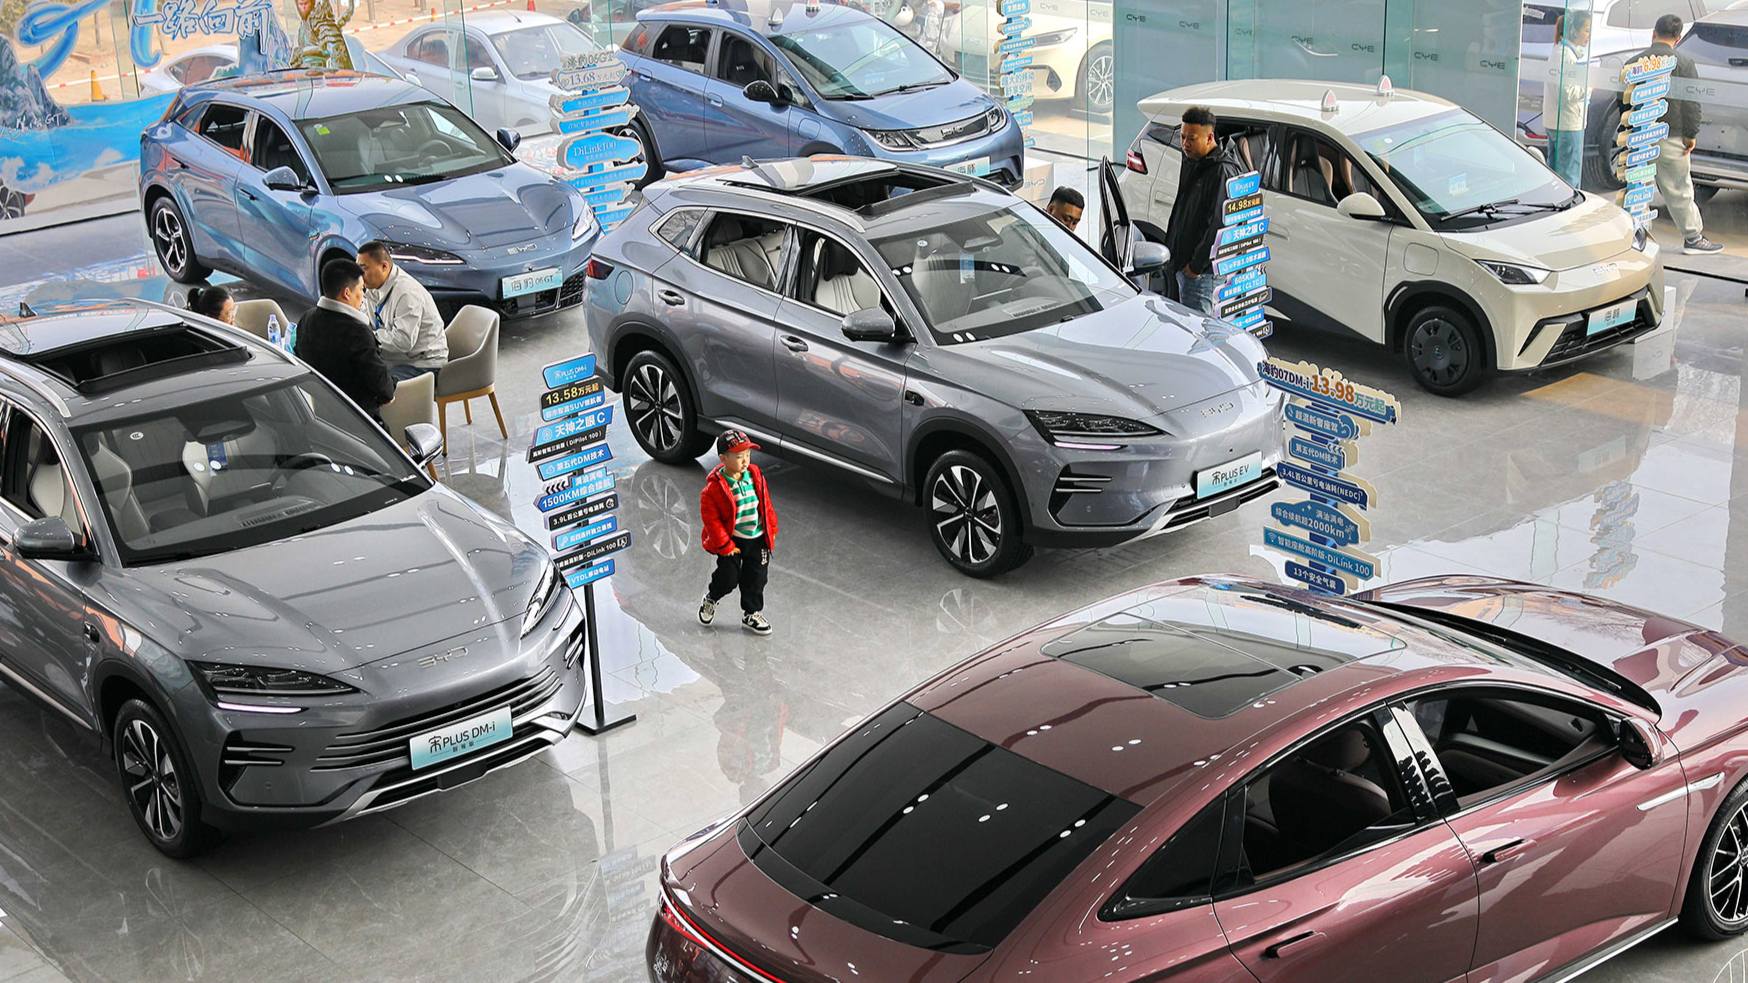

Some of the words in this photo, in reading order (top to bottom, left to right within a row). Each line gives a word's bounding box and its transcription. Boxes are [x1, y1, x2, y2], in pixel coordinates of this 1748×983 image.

[133, 0, 271, 54] 一路向前
[1233, 224, 1258, 240] 天神之眼
[1259, 222, 1264, 231] C
[546, 383, 600, 405] 13.58万元起
[555, 414, 596, 437] 天神之眼
[597, 412, 606, 423] C
[556, 449, 605, 470] 第五代DM技术
[1295, 443, 1338, 464] 第五代DM技术
[1212, 469, 1238, 485] 宋PLUS
[1239, 464, 1250, 475] EV
[542, 478, 612, 508] 1500KM综合续航
[1275, 507, 1345, 538] 综合续航超2000km
[1315, 510, 1344, 526] 满油满电
[606, 542, 617, 550] 100
[1293, 567, 1336, 589] 13个安全气囊
[1355, 563, 1370, 576] 100
[418, 646, 468, 668] BYD
[428, 730, 470, 754] 宋PLUS
[472, 721, 496, 738] DM-i
